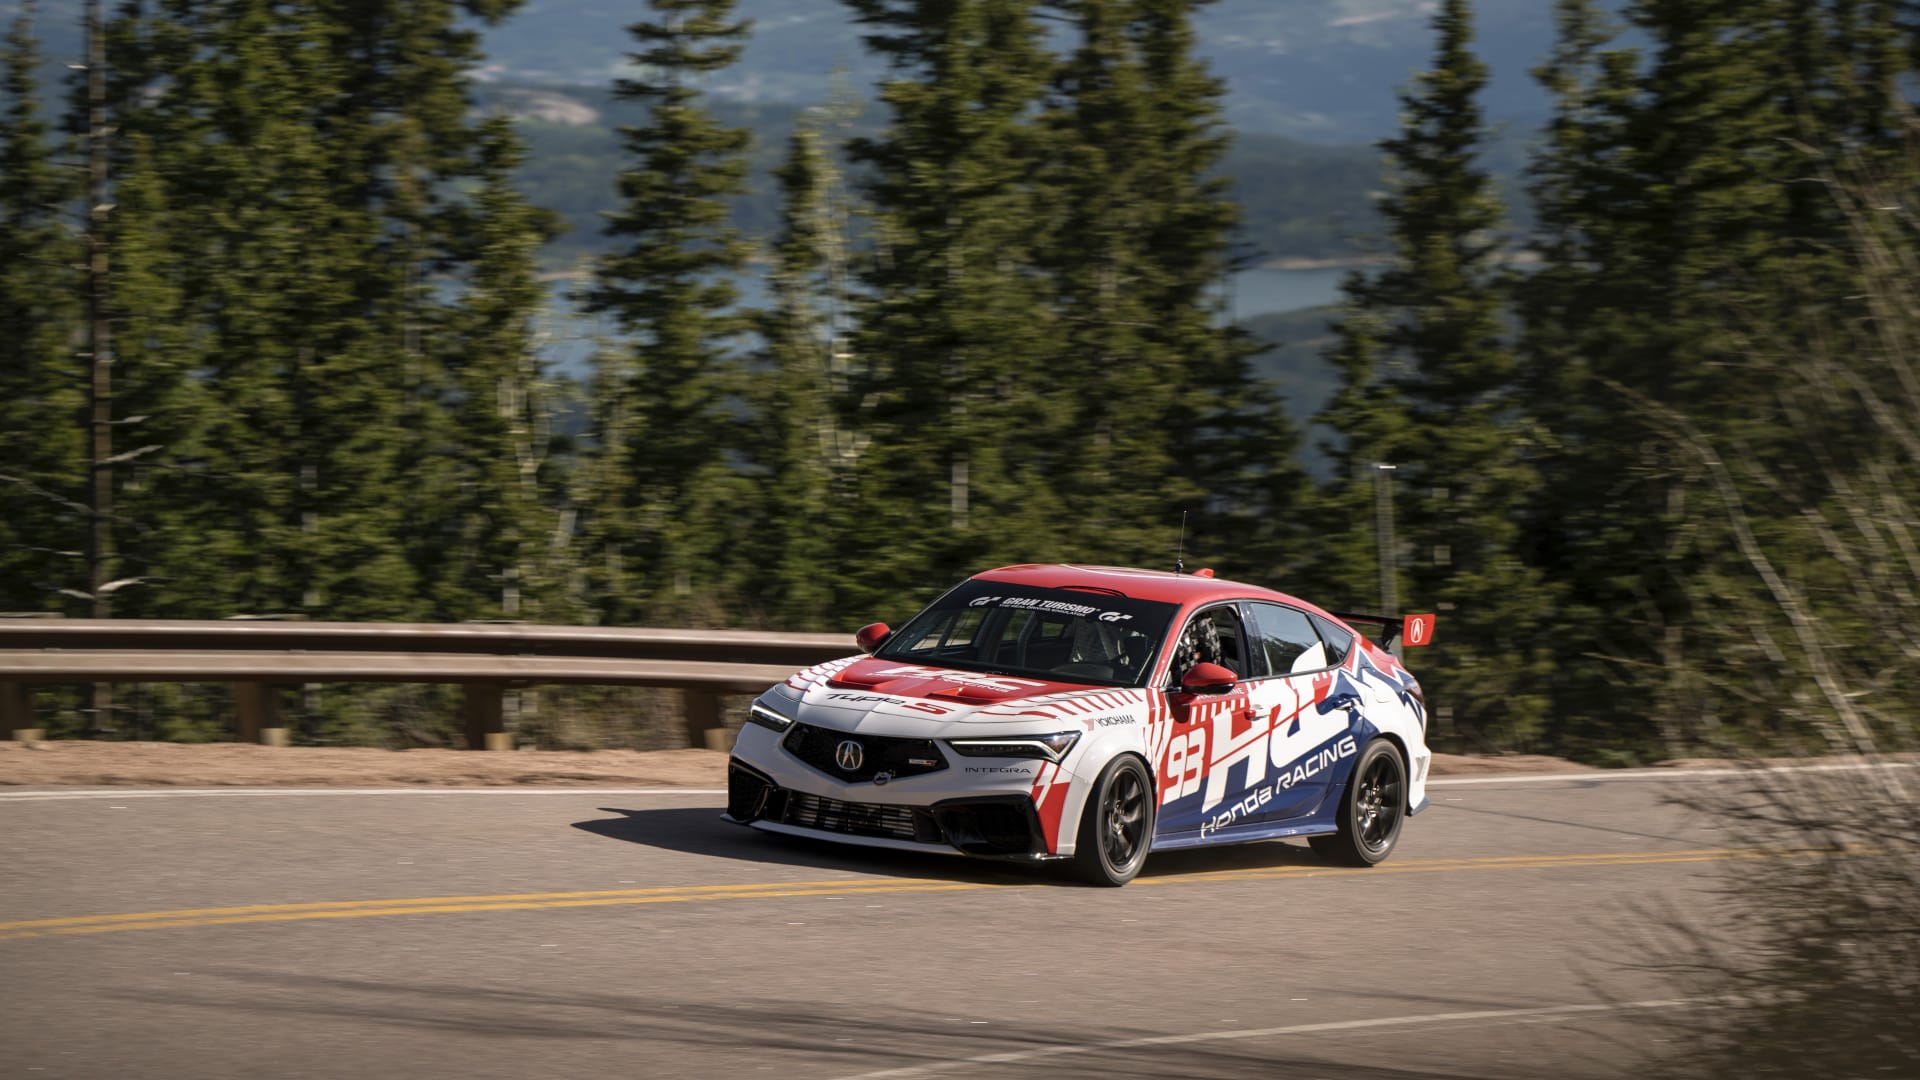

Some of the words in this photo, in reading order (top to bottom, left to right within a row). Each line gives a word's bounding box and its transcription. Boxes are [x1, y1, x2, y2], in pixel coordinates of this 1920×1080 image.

[1003, 597, 1039, 607] GRAN
[1040, 600, 1095, 614] TURISMO
[826, 693, 906, 705] Type
[901, 702, 956, 715] S
[1095, 714, 1136, 727] YOKOHAMA
[1163, 727, 1206, 805] 93
[1201, 784, 1273, 840] Honda
[1275, 734, 1357, 795] RACING
